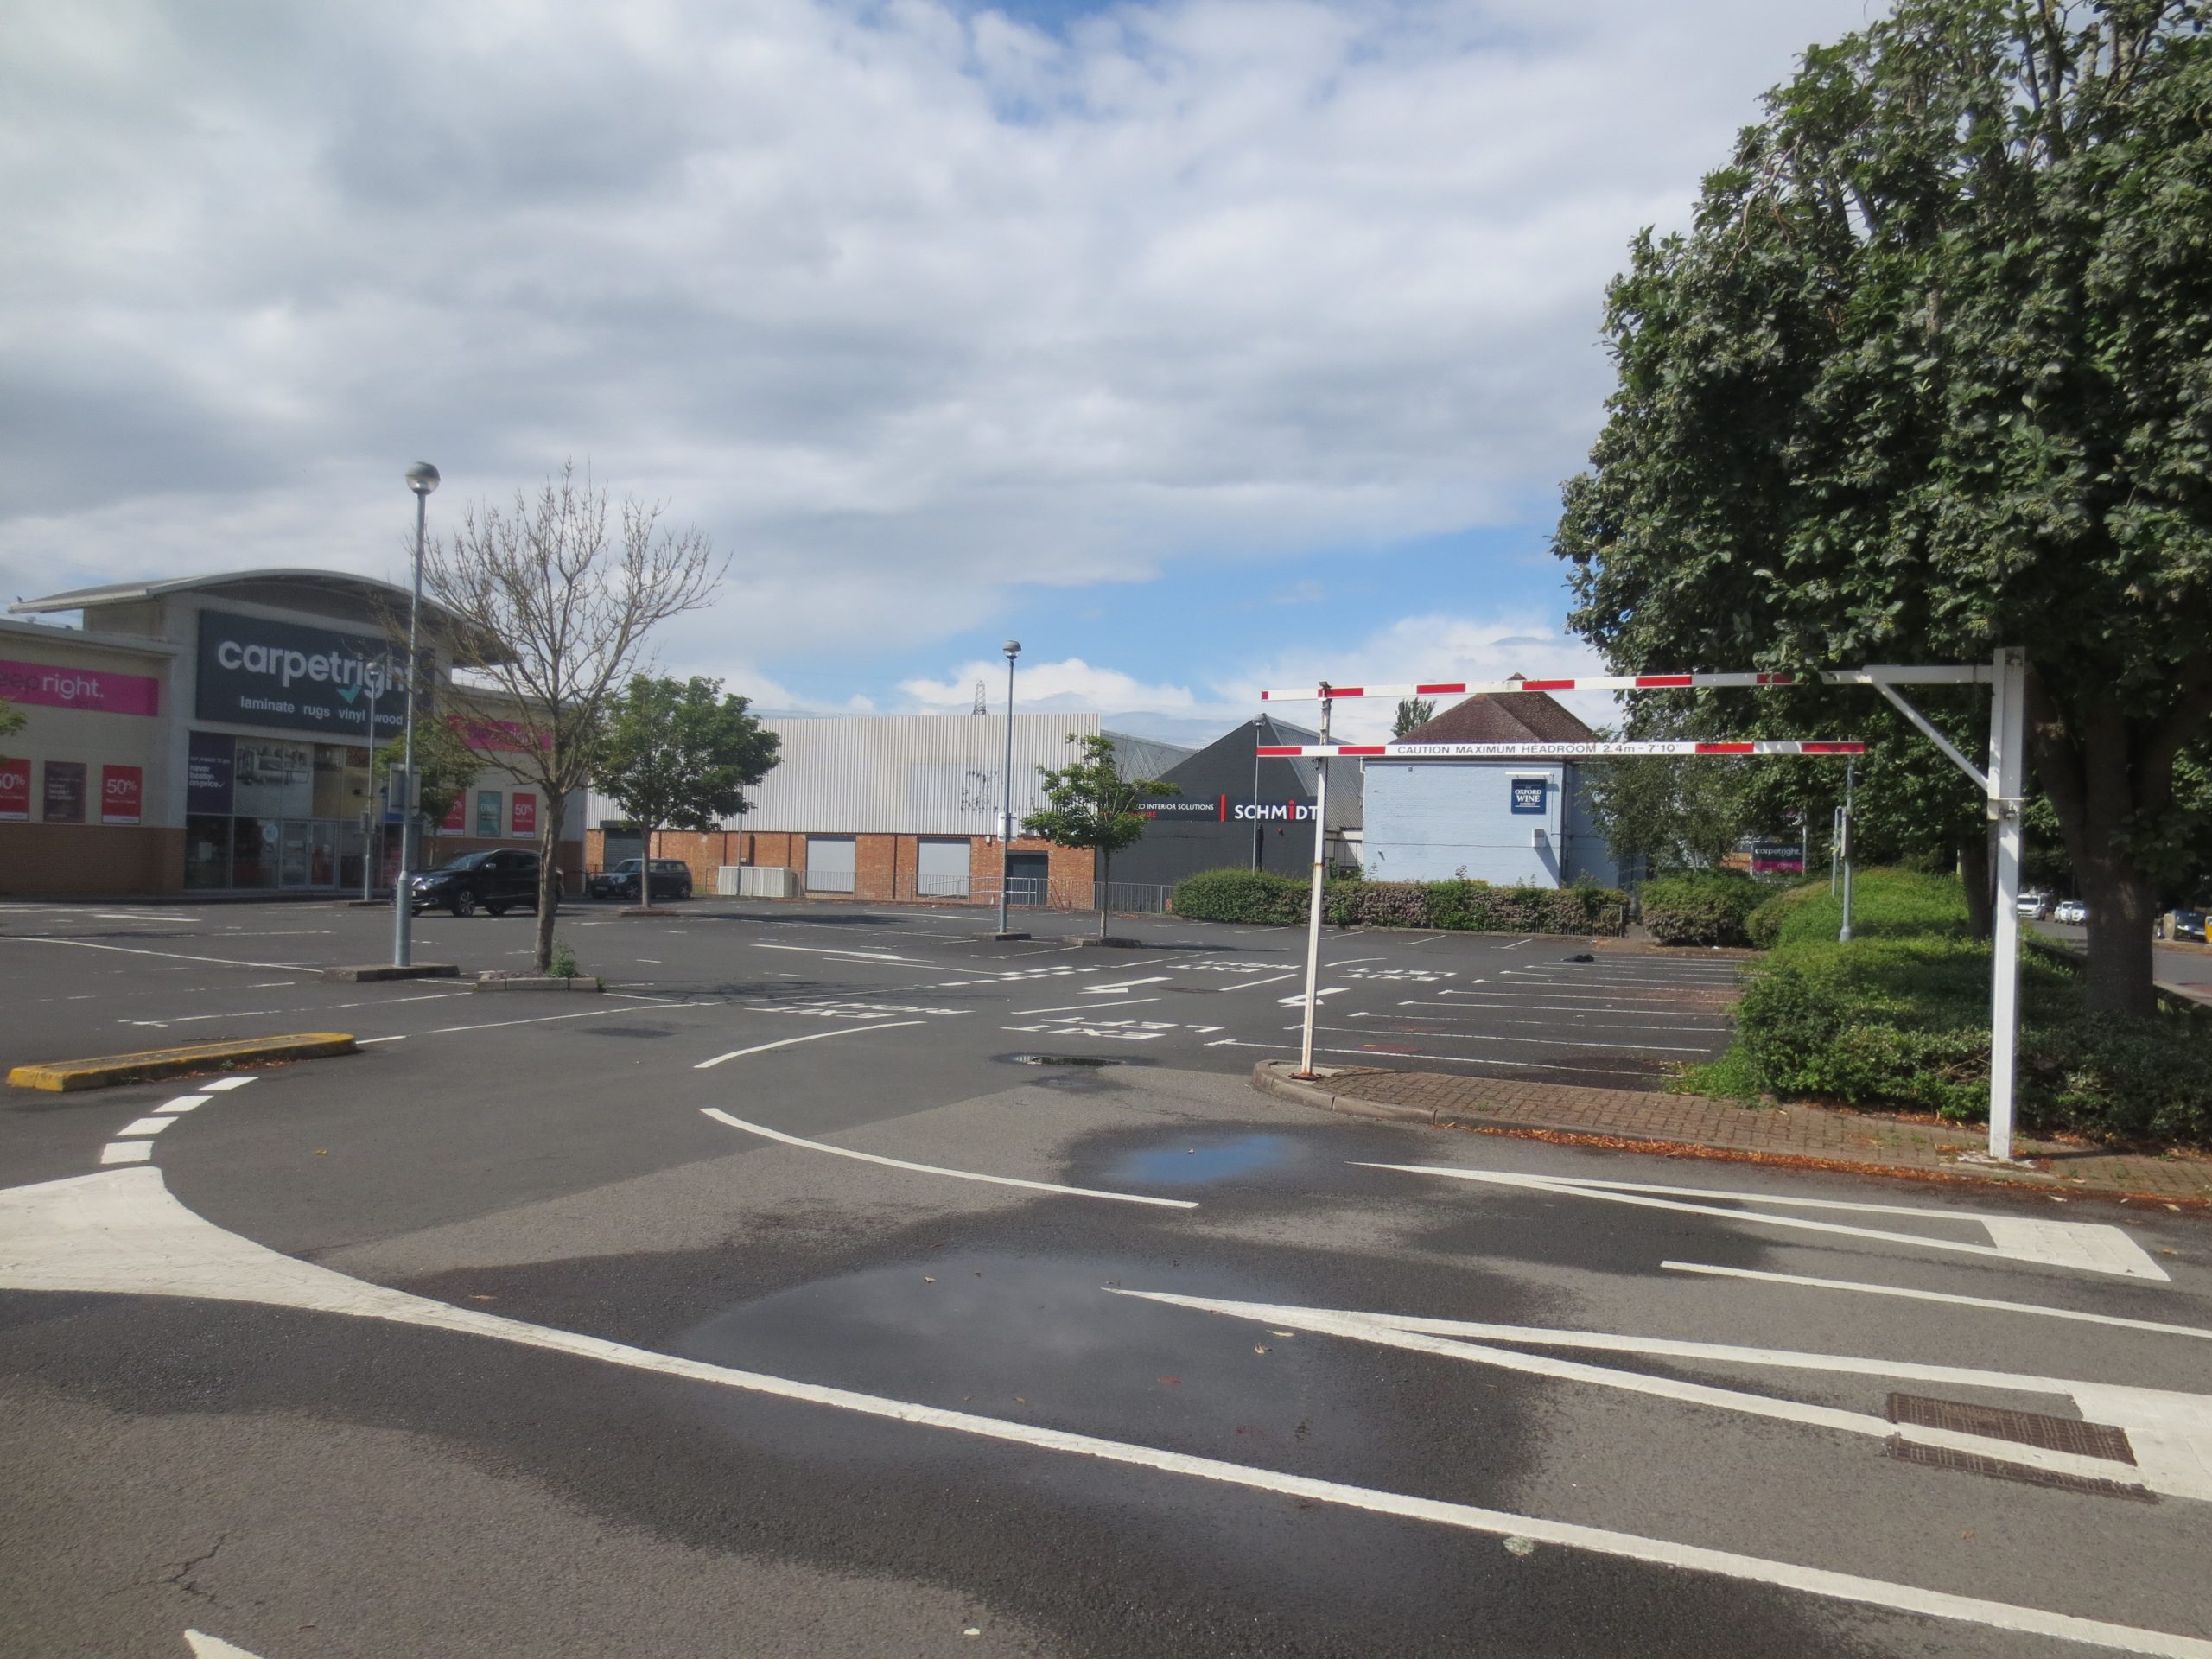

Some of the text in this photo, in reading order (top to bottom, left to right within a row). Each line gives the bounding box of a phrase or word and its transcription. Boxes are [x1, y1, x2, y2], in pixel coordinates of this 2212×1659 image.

[240, 696, 404, 726] laminate rugs vinyl wood
[1397, 745, 1451, 754] CAUTION
[1456, 745, 1516, 754] MAXIMUM
[1522, 744, 1597, 753] HEADROOM
[1603, 744, 1636, 753] 2.4m
[106, 779, 137, 794] 50%
[515, 804, 533, 816] 50%
[1166, 964, 1262, 973] EXIT
[1346, 968, 1457, 976] LEFT
[1338, 973, 1440, 982] EXIT
[744, 1007, 895, 1019] EXIT
[1039, 1017, 1225, 1033] LEFT
[1001, 1025, 1166, 1039] EXIT
